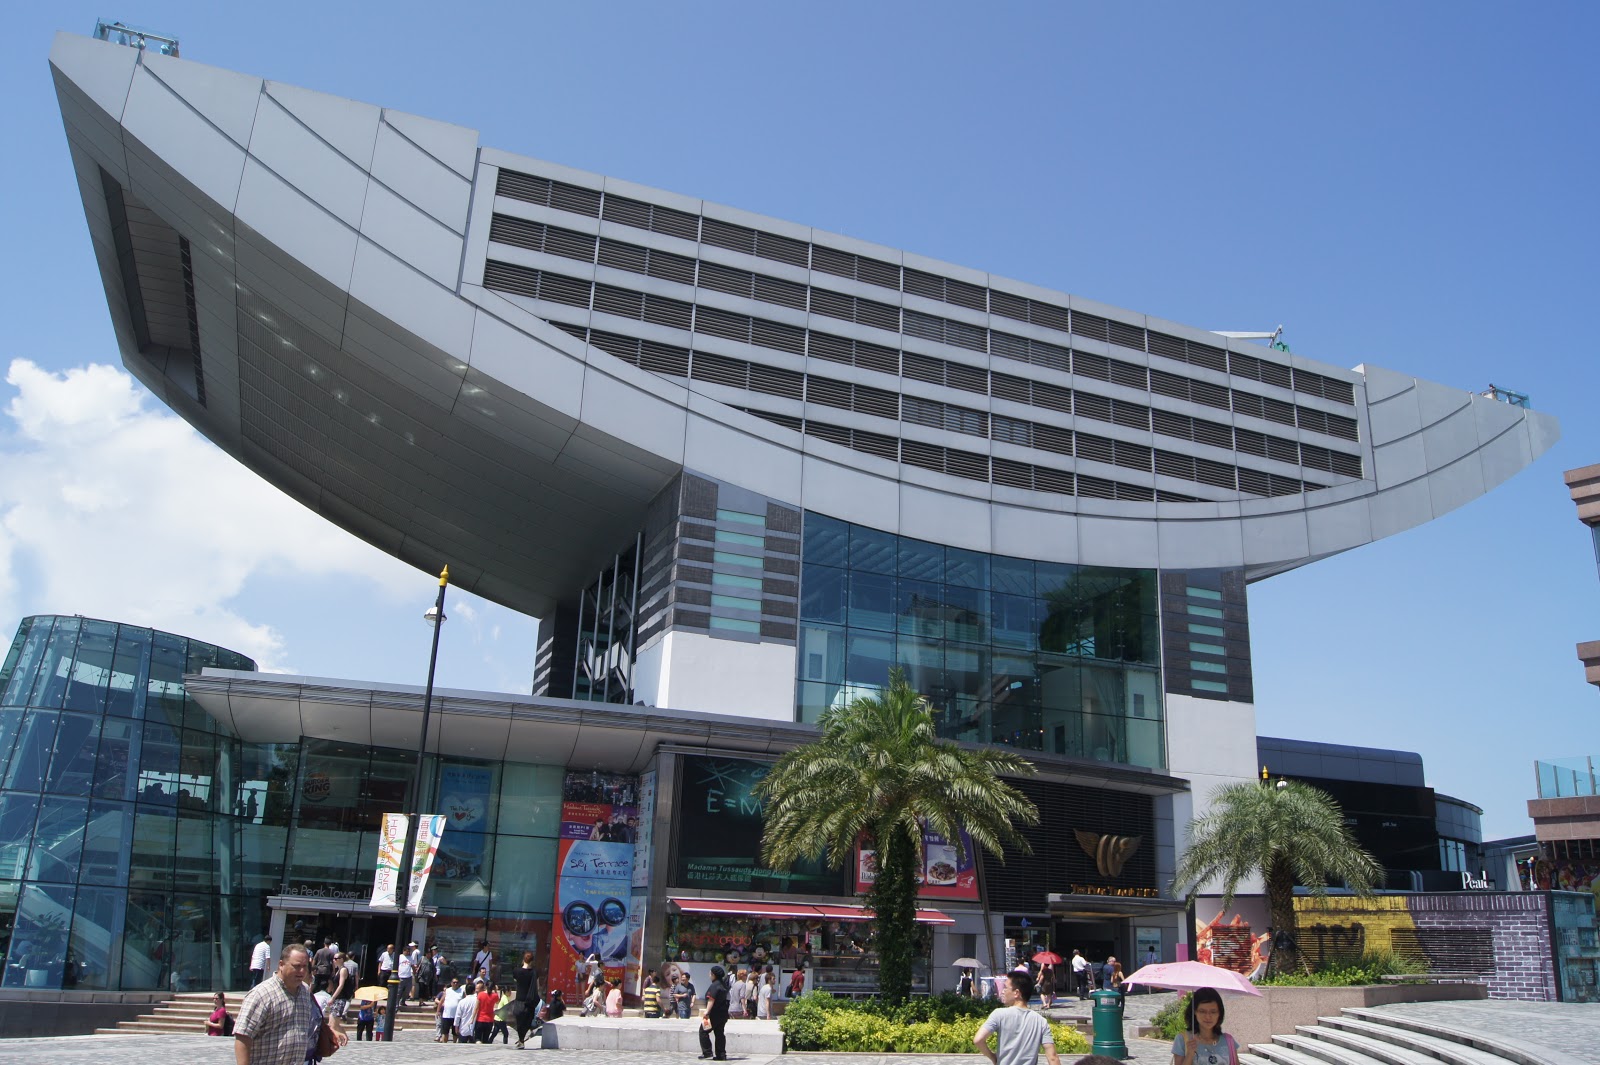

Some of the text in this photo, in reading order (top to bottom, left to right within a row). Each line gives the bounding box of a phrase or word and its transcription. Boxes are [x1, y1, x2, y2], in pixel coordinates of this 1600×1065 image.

[304, 782, 330, 795] KING
[387, 819, 398, 853] HONG
[590, 857, 629, 868] Terrace
[687, 863, 717, 871] Madame
[719, 865, 752, 874] Tussauds
[752, 867, 772, 877] Hong
[382, 856, 391, 892] KONG
[1461, 870, 1489, 890] Pearl
[280, 883, 360, 899] The Peak Tower
